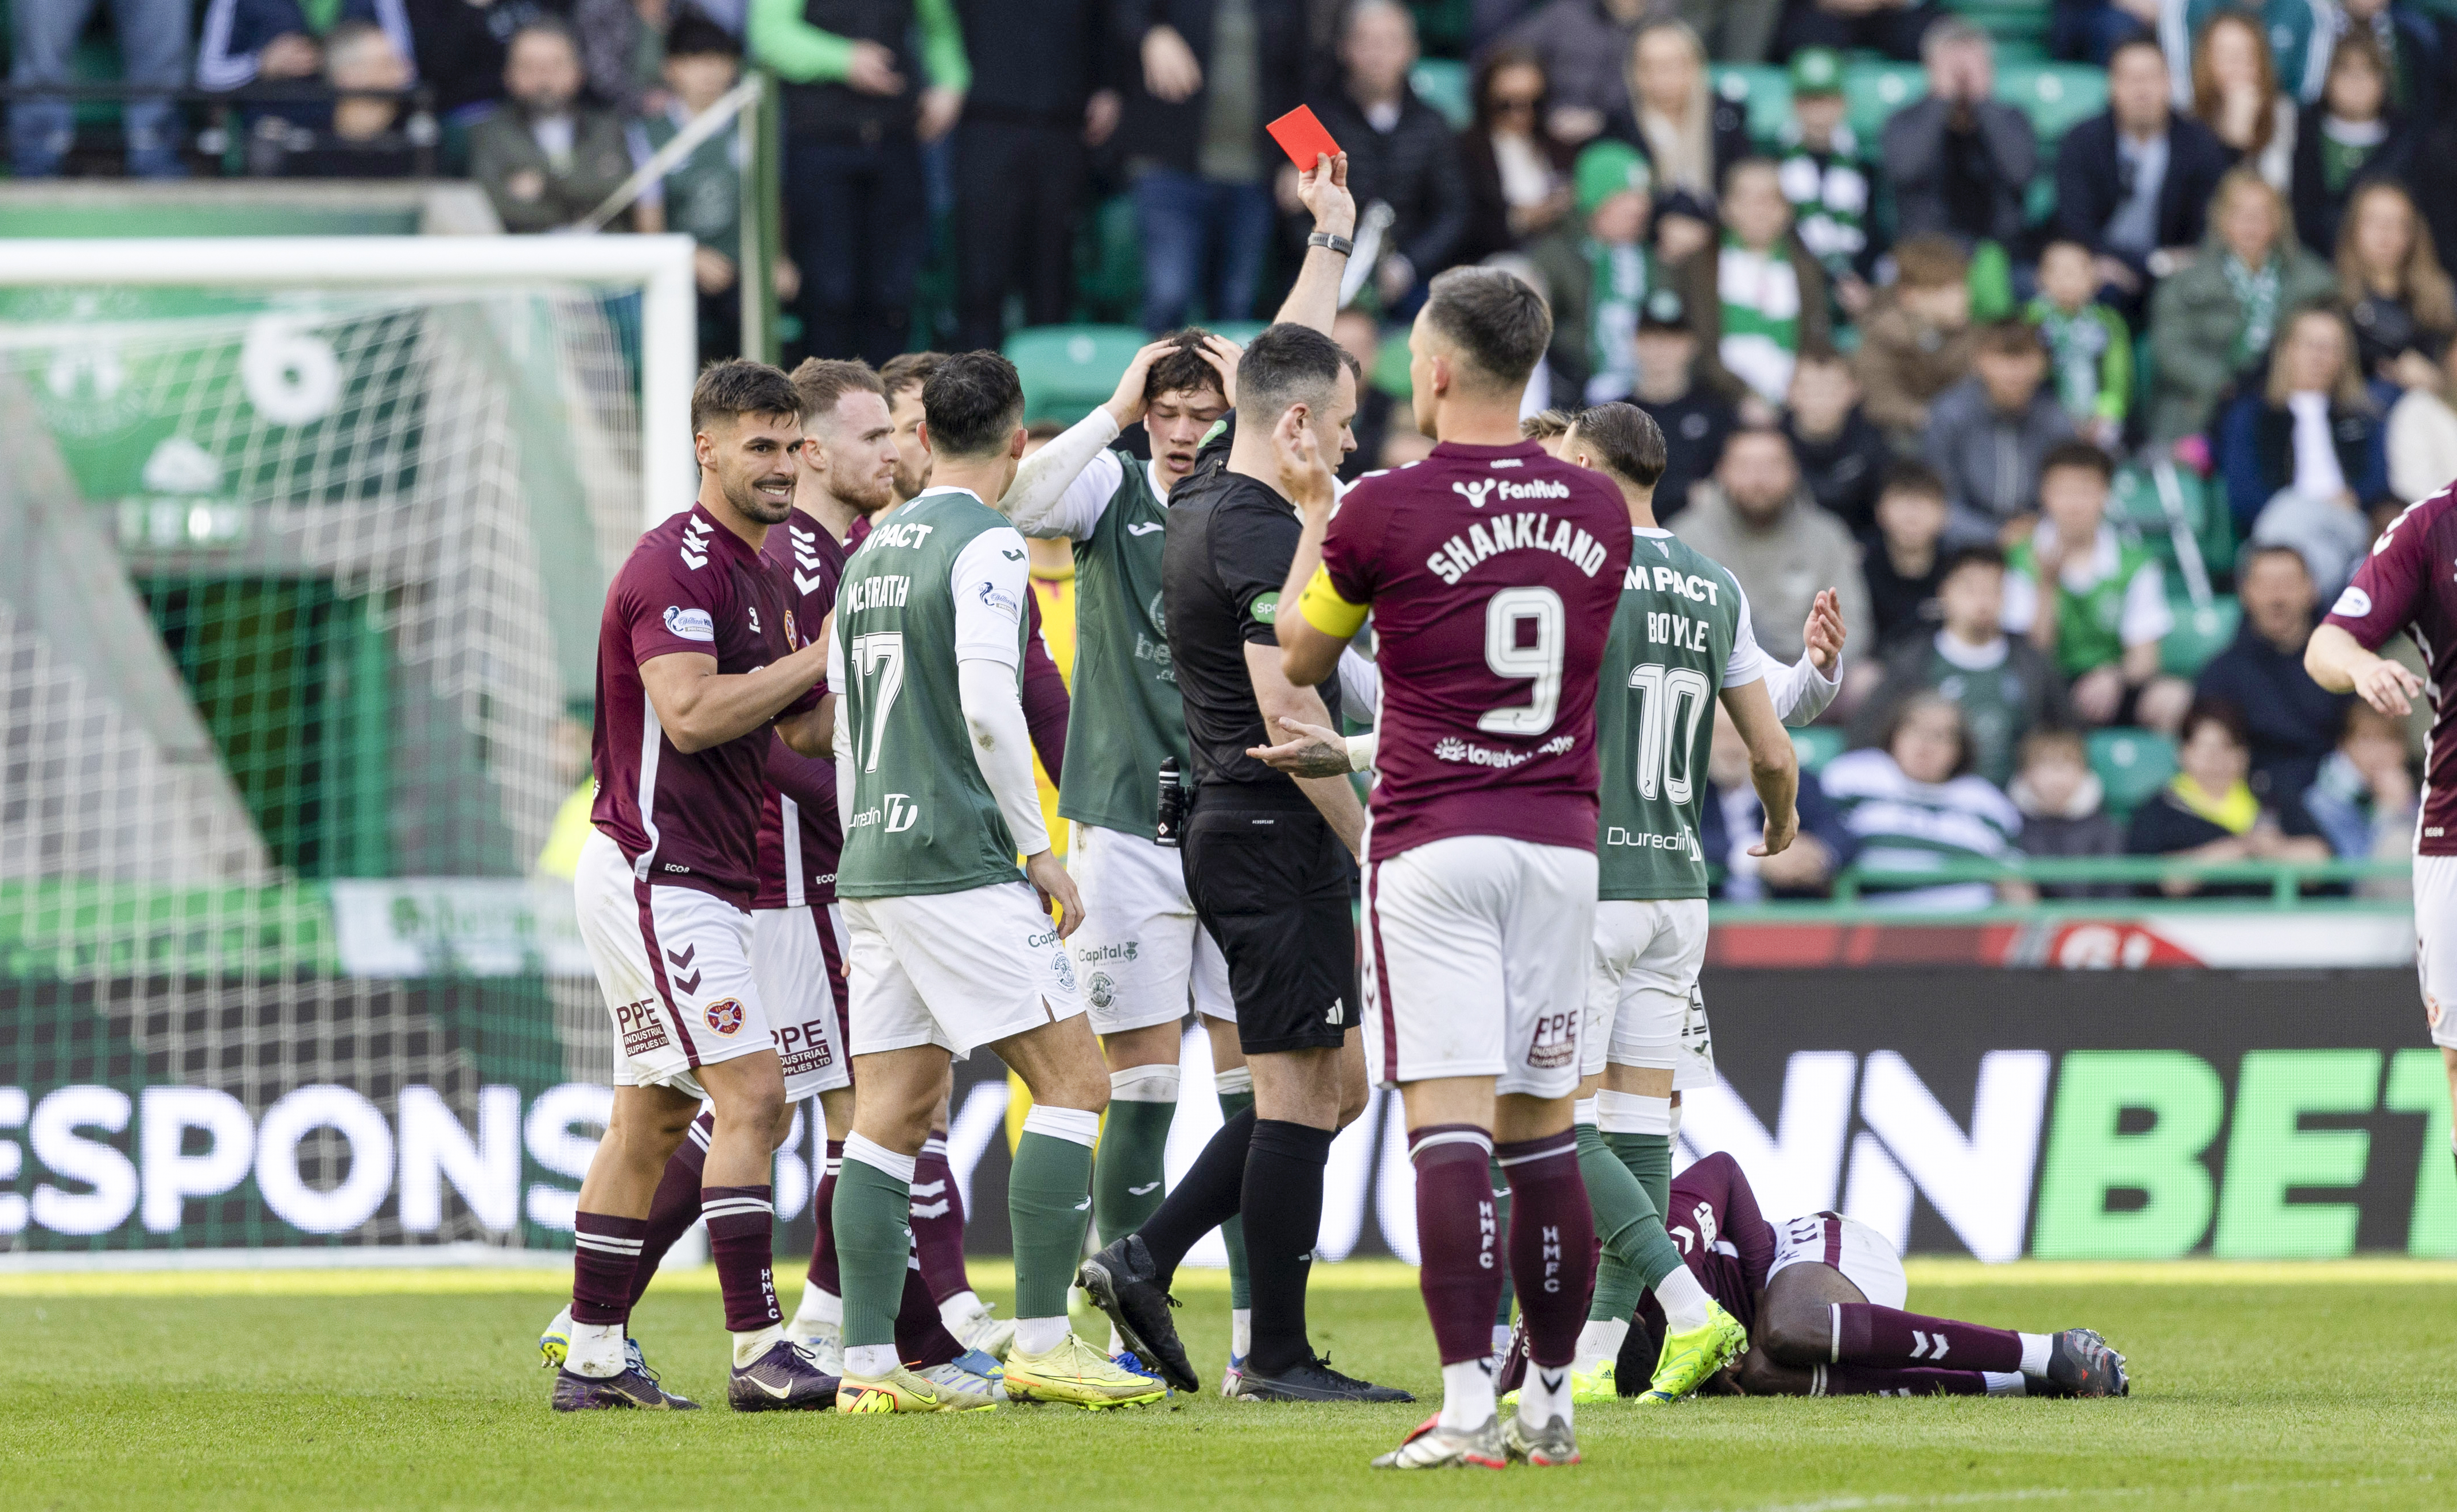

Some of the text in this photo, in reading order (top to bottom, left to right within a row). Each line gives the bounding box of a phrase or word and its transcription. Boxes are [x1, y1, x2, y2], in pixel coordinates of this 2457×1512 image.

[1498, 479, 1570, 501] FanHub
[1427, 512, 1607, 585] SHANKLAND
[1257, 602, 1278, 614] Spe
[1648, 611, 1709, 652] BOYLE
[1135, 632, 1172, 665] be
[1477, 586, 1566, 735] 9
[1628, 663, 1711, 805] 10
[816, 873, 837, 884] ECO
[1078, 944, 1122, 967] Capital
[616, 998, 660, 1034] PPE
[624, 1026, 664, 1045] INDUSTRIAL
[626, 1036, 668, 1056] SUPPLIES LTD
[780, 1047, 828, 1066] DUSTRIAL
[782, 1057, 831, 1075] PPLIES LTD
[1543, 1225, 1562, 1293] HMFC
[761, 1269, 779, 1319] HMFC
